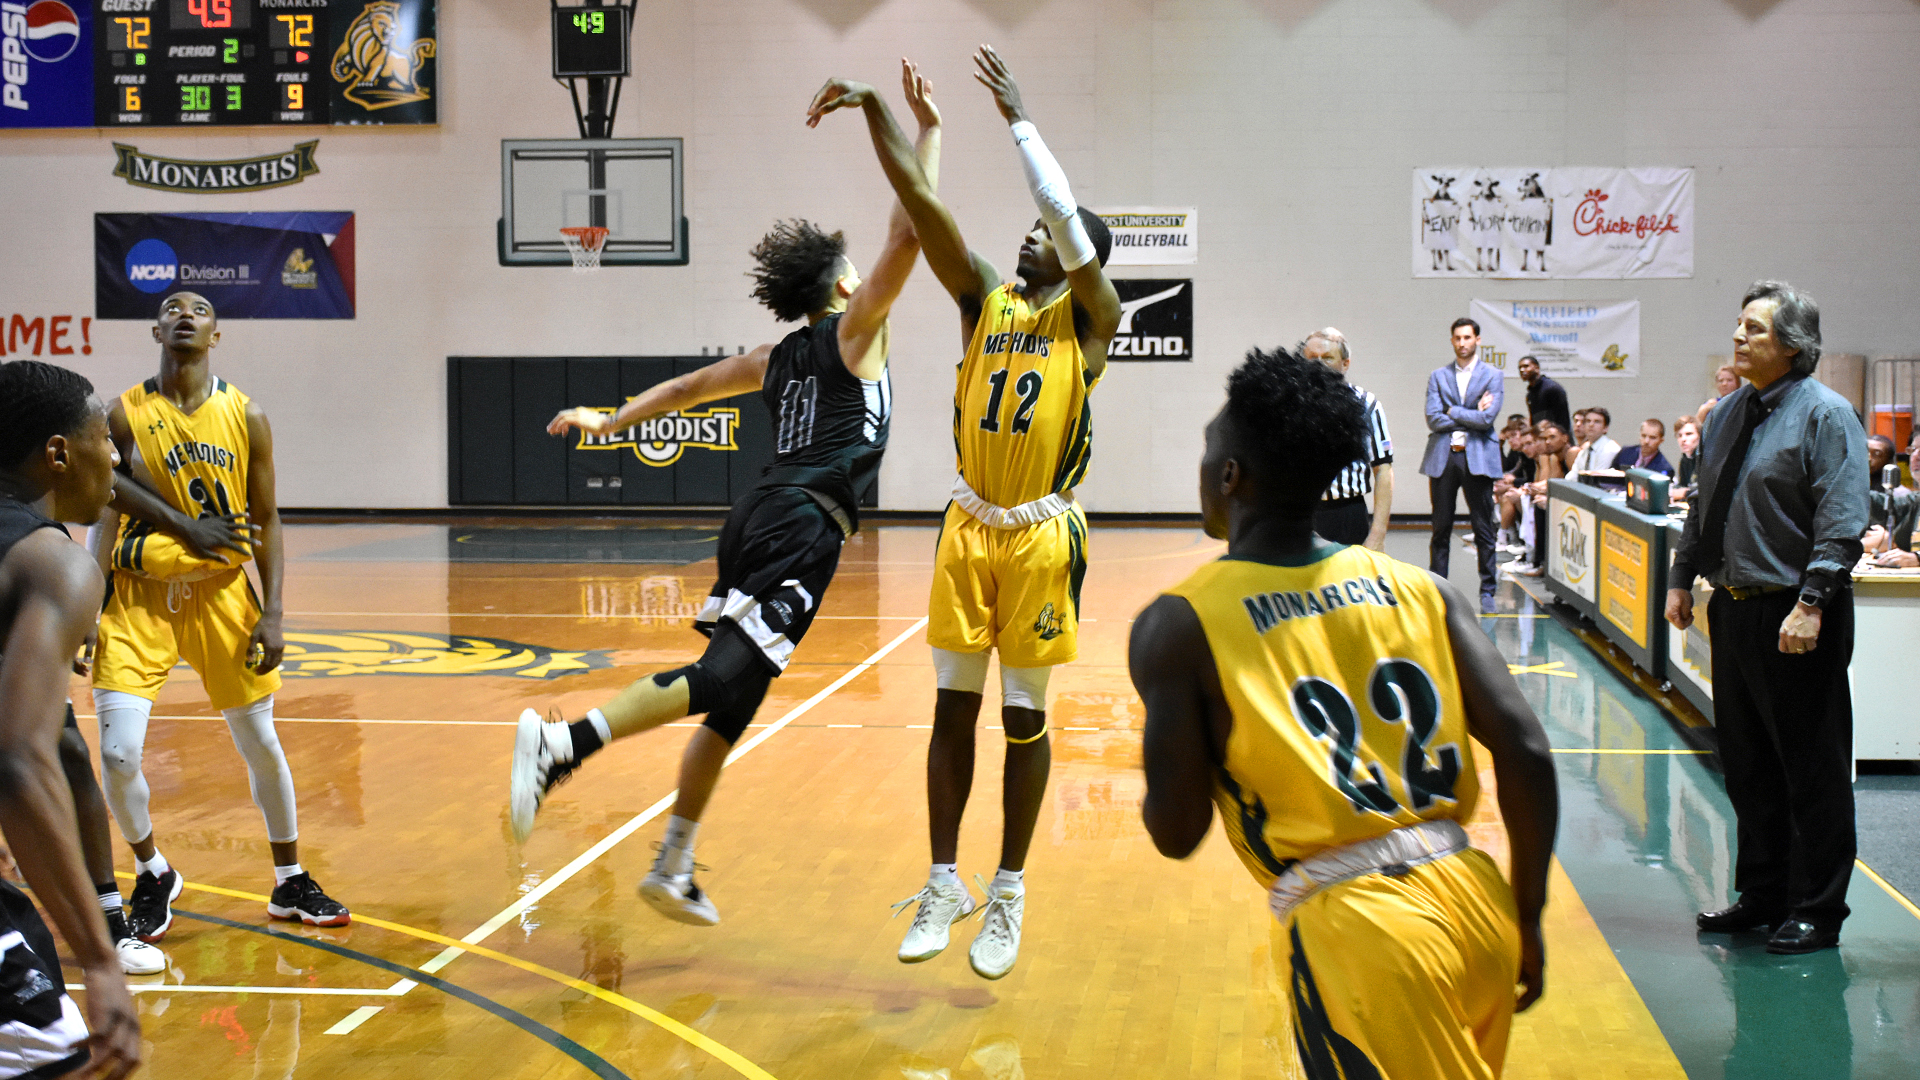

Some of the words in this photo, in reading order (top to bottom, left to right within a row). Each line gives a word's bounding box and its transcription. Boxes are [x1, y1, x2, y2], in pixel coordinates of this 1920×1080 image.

[114, 17, 150, 49] 72
[276, 14, 313, 47] 72
[2, 1, 29, 110] PEPSI
[168, 45, 217, 58] PERIOD
[223, 38, 239, 63] 2
[114, 74, 146, 84] FOULS
[276, 72, 309, 83] FOULS
[125, 86, 141, 111] 6
[181, 85, 211, 110] 30
[226, 85, 242, 110] 3
[287, 83, 304, 109] 9
[118, 113, 142, 123] WON
[181, 112, 212, 123] GAME
[280, 111, 304, 121] WON
[133, 153, 298, 188] MONARCHS
[1573, 195, 1680, 239] Chick-fil-A
[1115, 233, 1188, 247] VOLLEYBALL
[129, 264, 176, 281] NCAA
[180, 264, 235, 280] Division
[1512, 302, 1598, 319] FAIRFIELD
[979, 367, 1044, 435] 12
[777, 375, 818, 454] 11
[165, 440, 236, 478] MEHODIST
[1243, 574, 1399, 637] MONARCHS
[1289, 657, 1462, 816] 22
